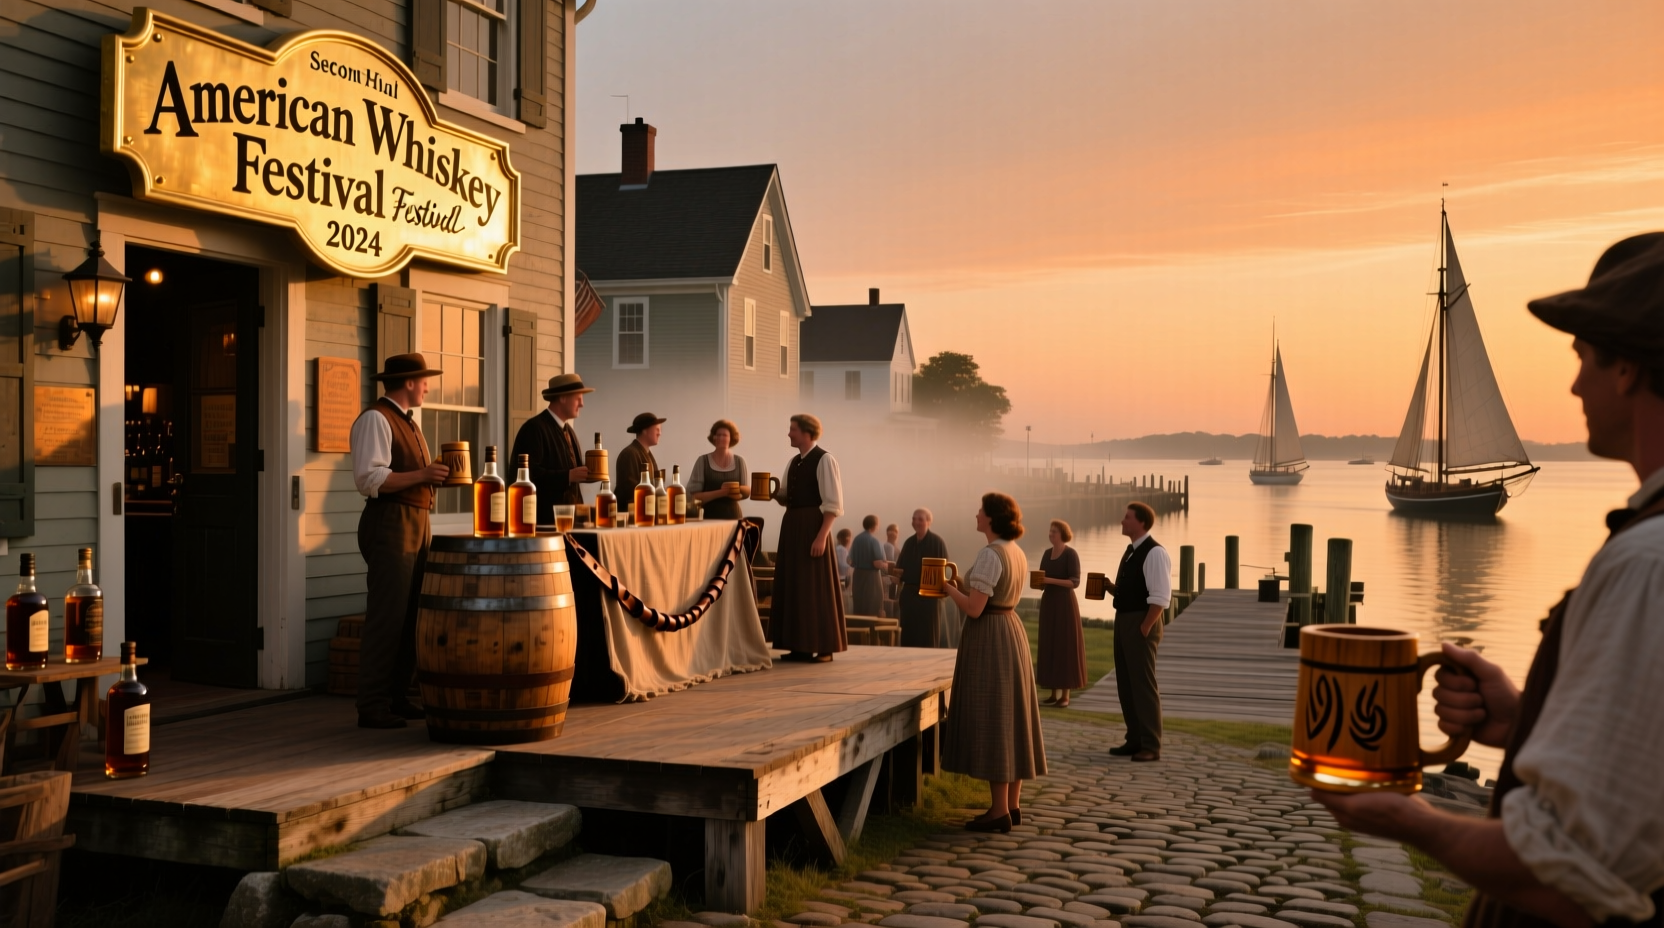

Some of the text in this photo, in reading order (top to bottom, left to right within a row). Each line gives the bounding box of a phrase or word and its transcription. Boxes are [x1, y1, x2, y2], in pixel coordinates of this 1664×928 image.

[143, 60, 501, 226] American Whiskey
[232, 132, 385, 219] Festival
[326, 221, 383, 257] 2024
